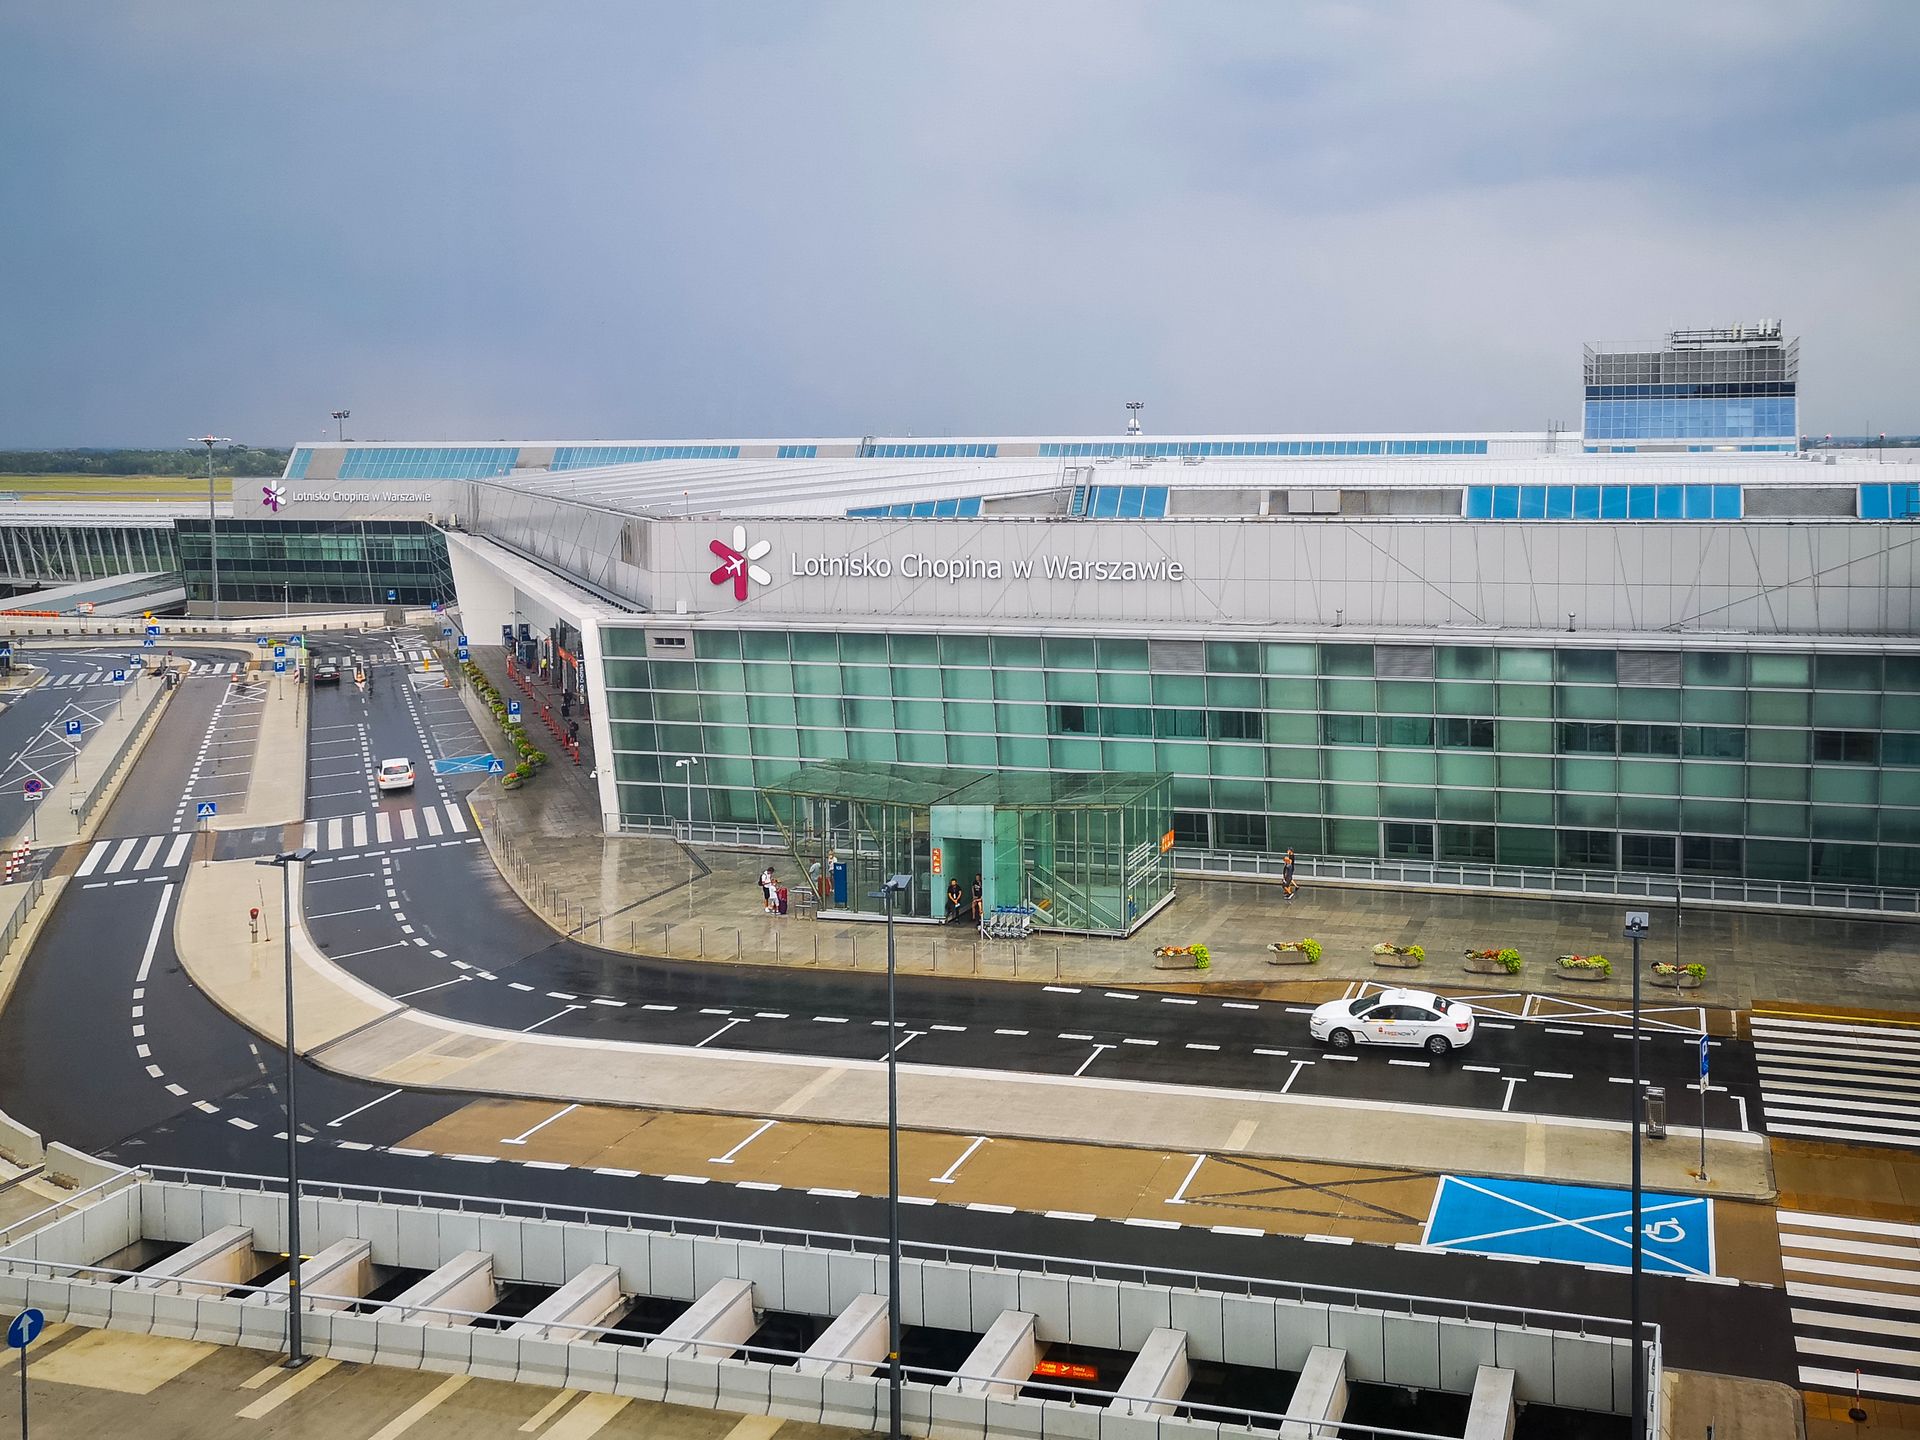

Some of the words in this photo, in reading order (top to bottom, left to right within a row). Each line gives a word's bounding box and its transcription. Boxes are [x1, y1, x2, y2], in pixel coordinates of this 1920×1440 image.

[292, 491, 330, 502] Lotnisko
[332, 491, 370, 504] Chopina
[382, 491, 431, 502] Warszawie
[791, 551, 892, 578] Lotnisko
[900, 553, 1002, 584] Chopina
[1012, 561, 1033, 580] w
[1042, 555, 1185, 582] Warszawie
